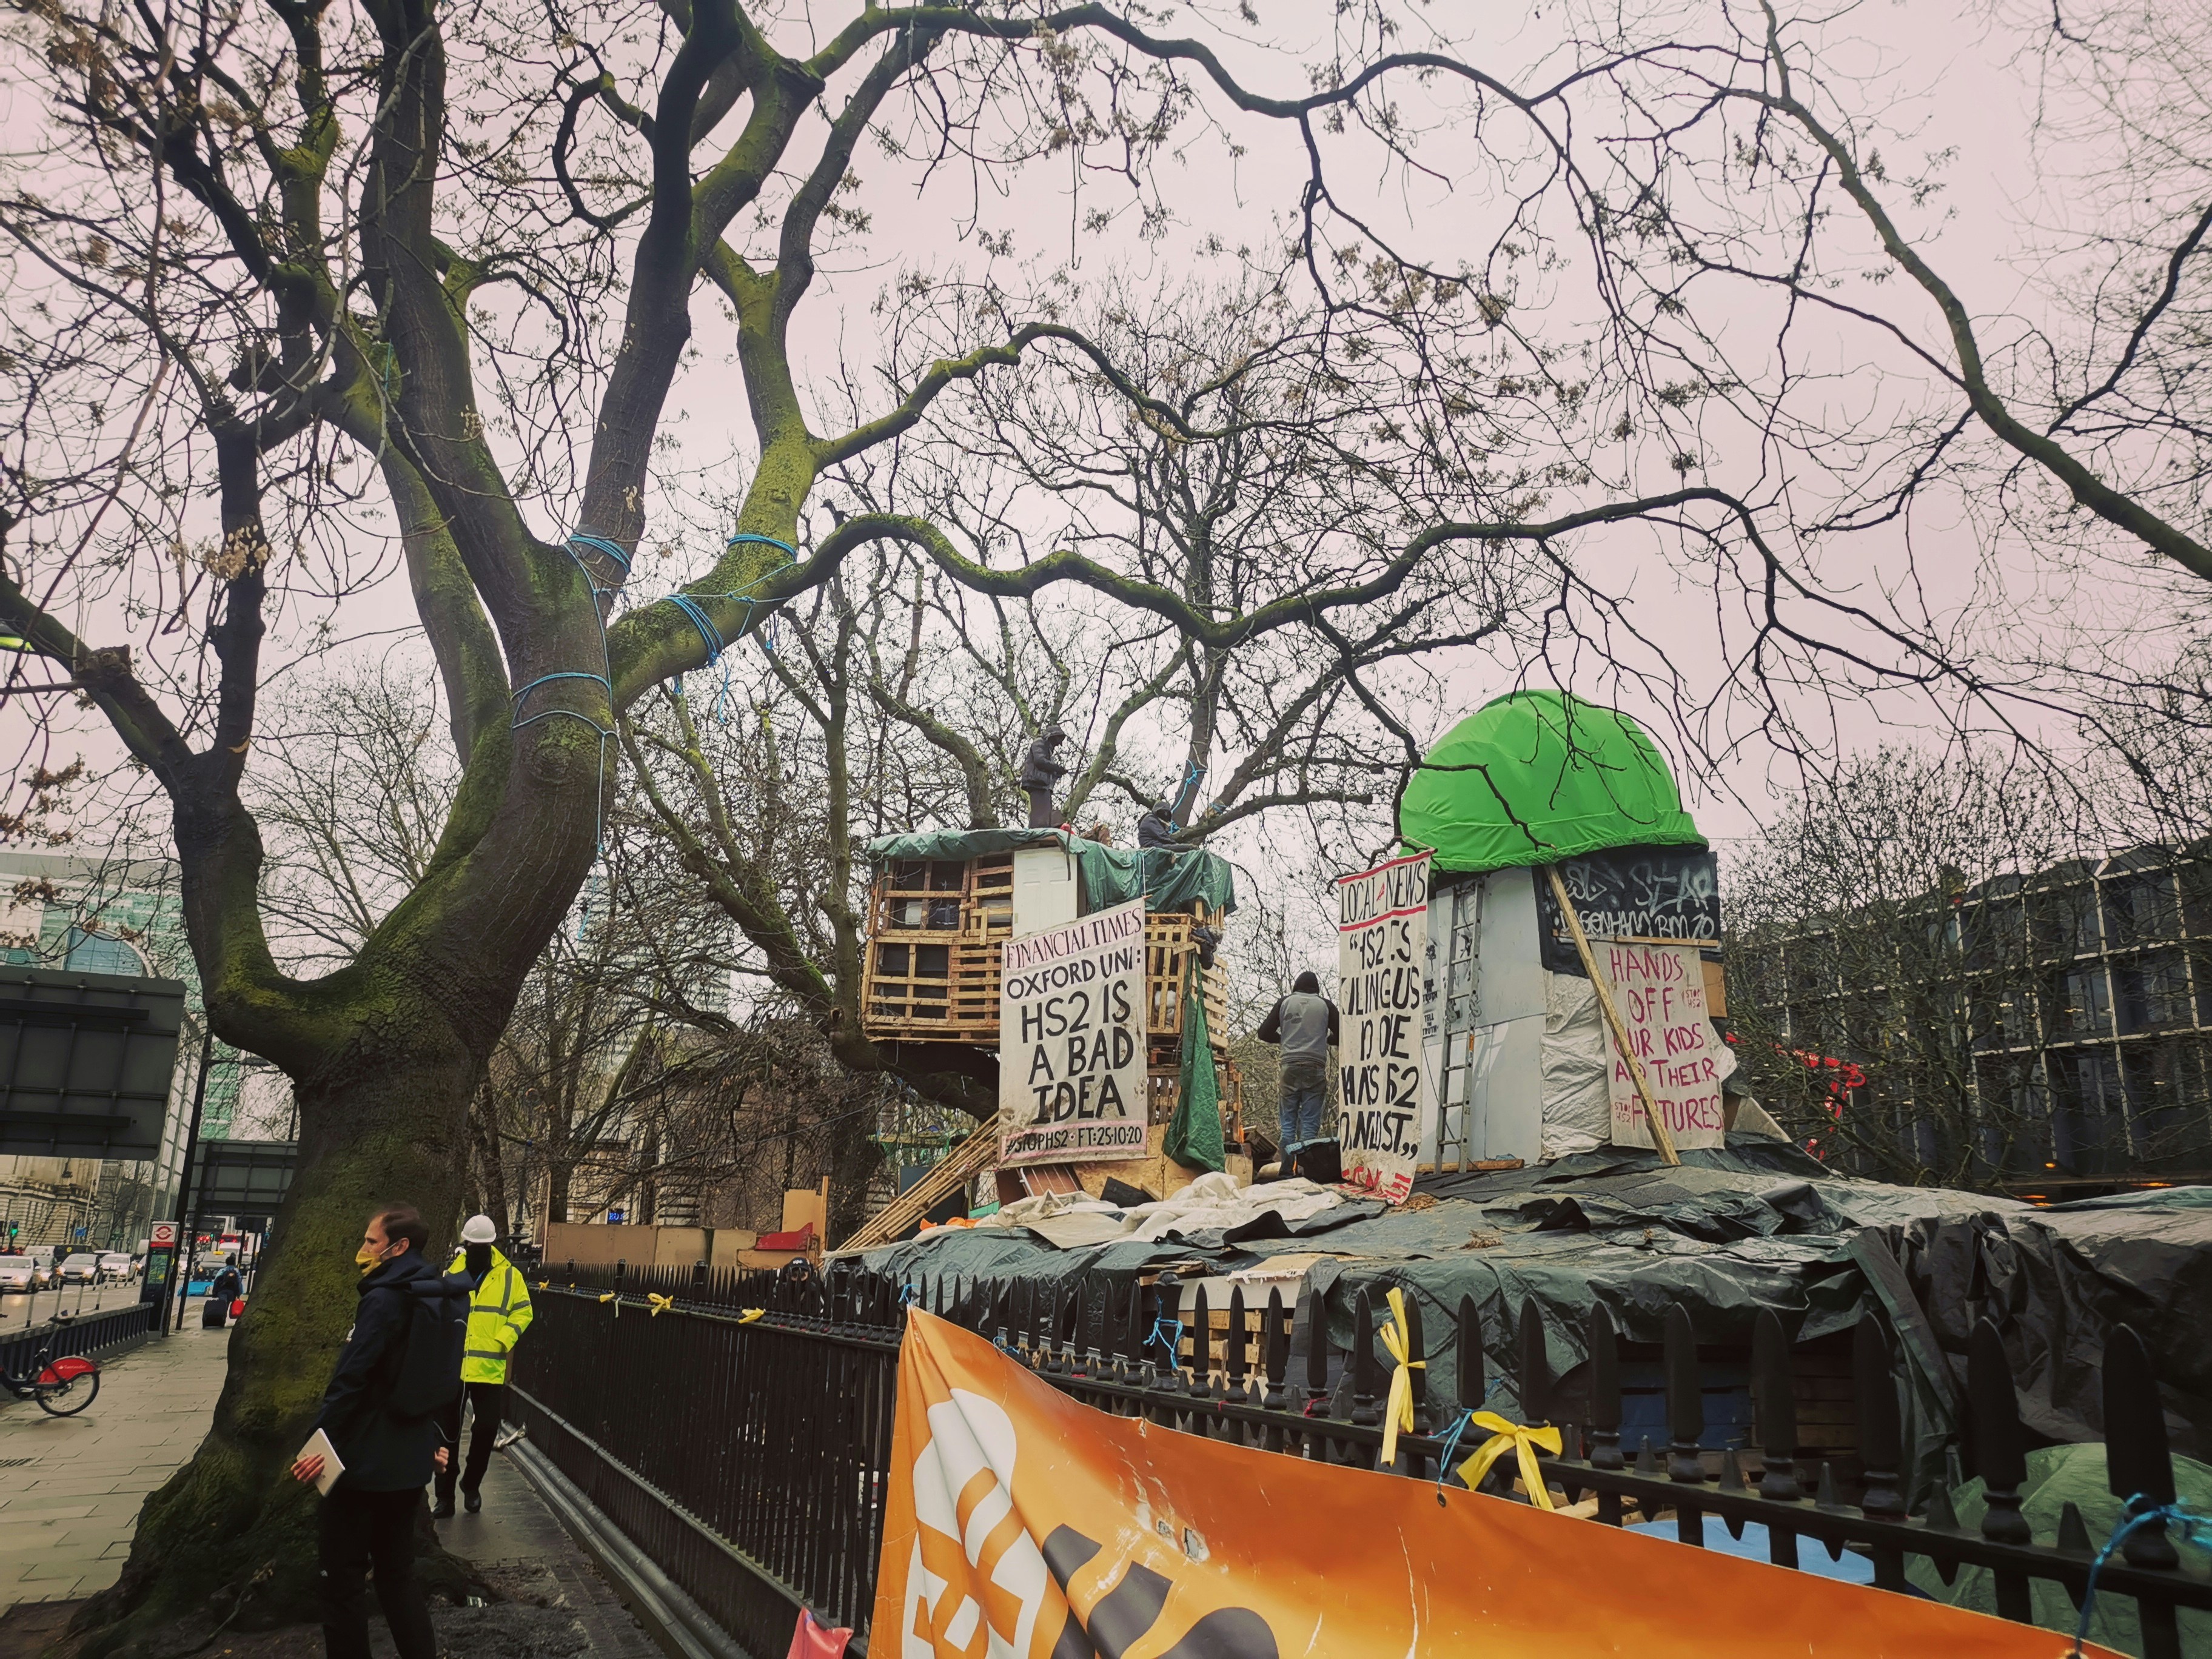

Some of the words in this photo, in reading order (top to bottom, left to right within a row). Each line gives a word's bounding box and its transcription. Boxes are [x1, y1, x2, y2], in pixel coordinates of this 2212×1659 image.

[1340, 877, 1378, 923] LOCAL
[1386, 861, 1426, 911] NEWS
[1006, 926, 1090, 968] FINANCIAL
[1090, 908, 1142, 946] TIMES
[1007, 959, 1096, 999] OXFORD
[1610, 947, 1683, 982] HANDS
[1022, 991, 1089, 1044] HS2
[1102, 980, 1130, 1024] IS
[1628, 987, 1674, 1024] OFF
[1686, 989, 1700, 998] STOP
[1687, 999, 1701, 1008] HS2
[1028, 1044, 1054, 1085] A
[1068, 1027, 1133, 1078] BAD
[1664, 1023, 1704, 1056] KIDS
[1615, 1060, 1646, 1082] AD
[1650, 1057, 1719, 1087] THEIR
[1032, 1074, 1126, 1124] IDEA
[1616, 1112, 1631, 1122] HS2
[1632, 1094, 1723, 1132] FTURES
